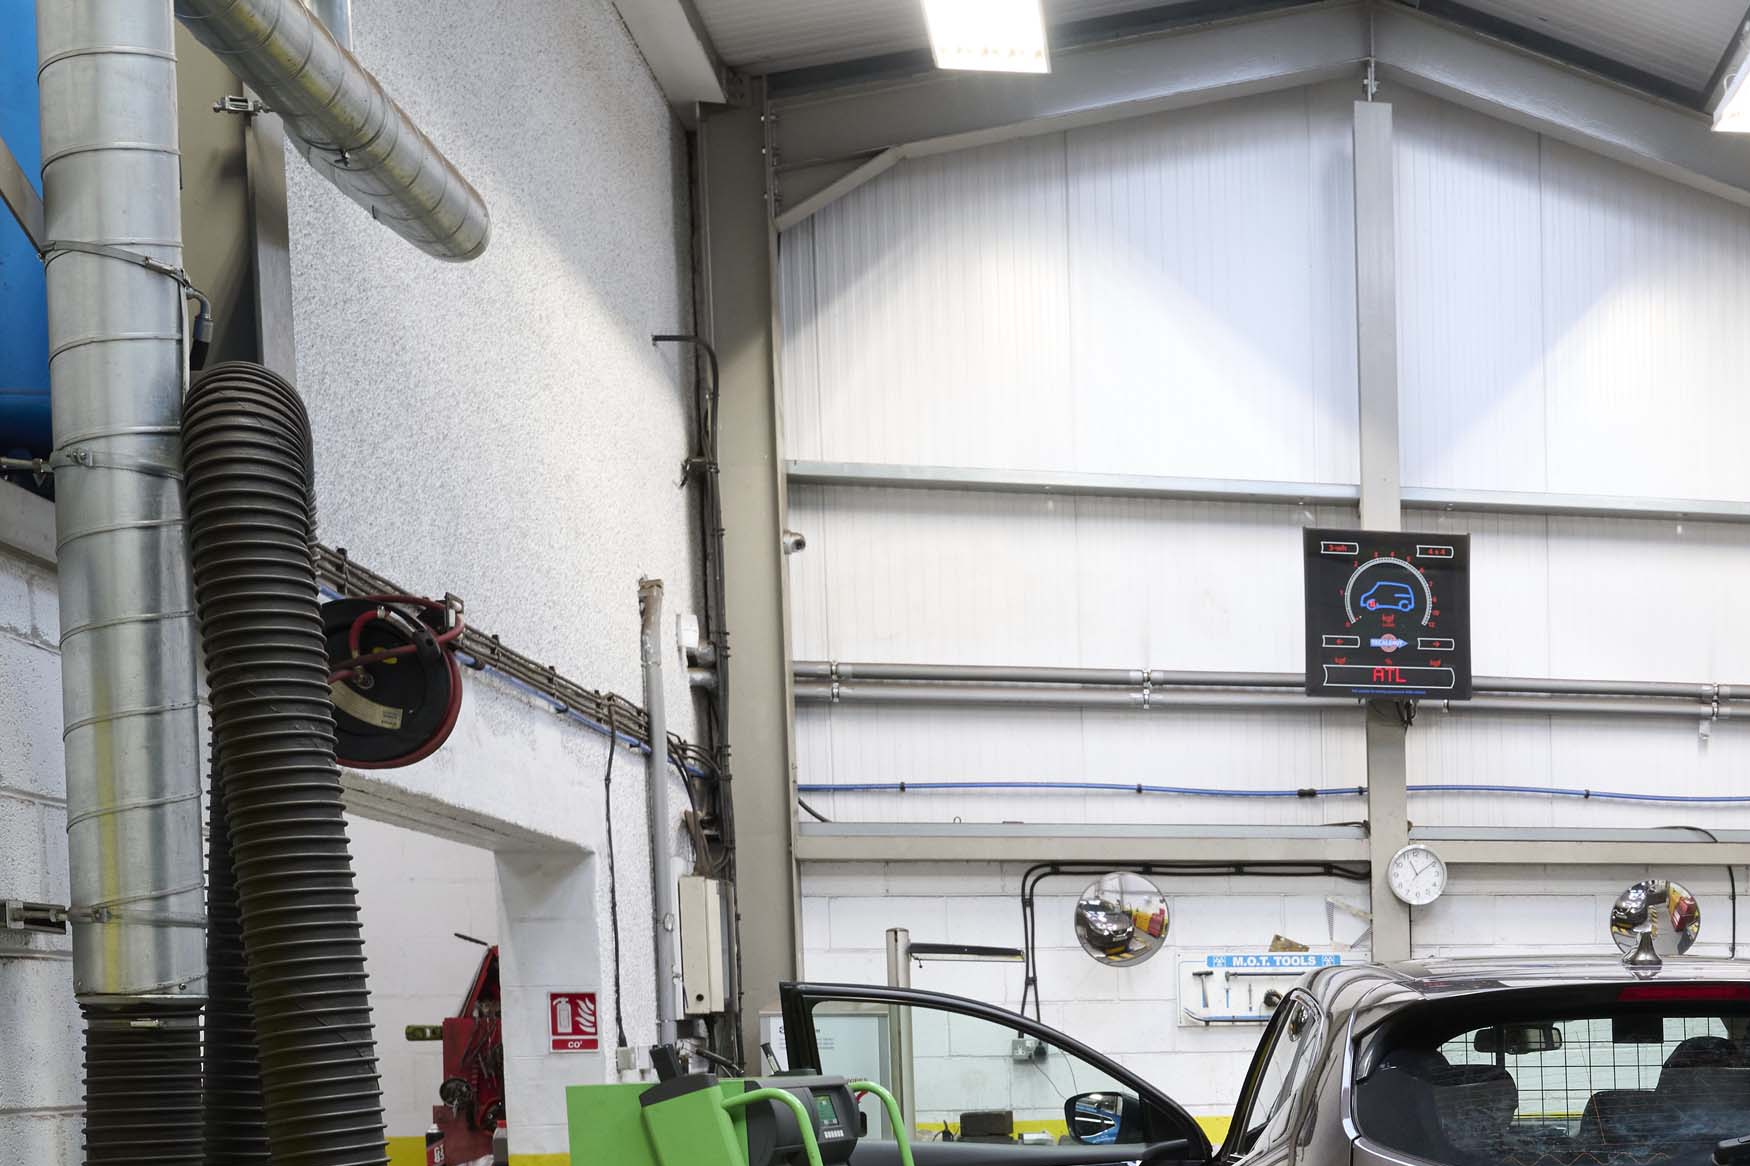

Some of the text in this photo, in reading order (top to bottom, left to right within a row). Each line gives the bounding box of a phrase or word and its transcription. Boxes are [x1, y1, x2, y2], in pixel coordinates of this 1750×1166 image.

[1372, 668, 1407, 683] ATL
[1232, 956, 1316, 967] M.O.T. TOOLS
